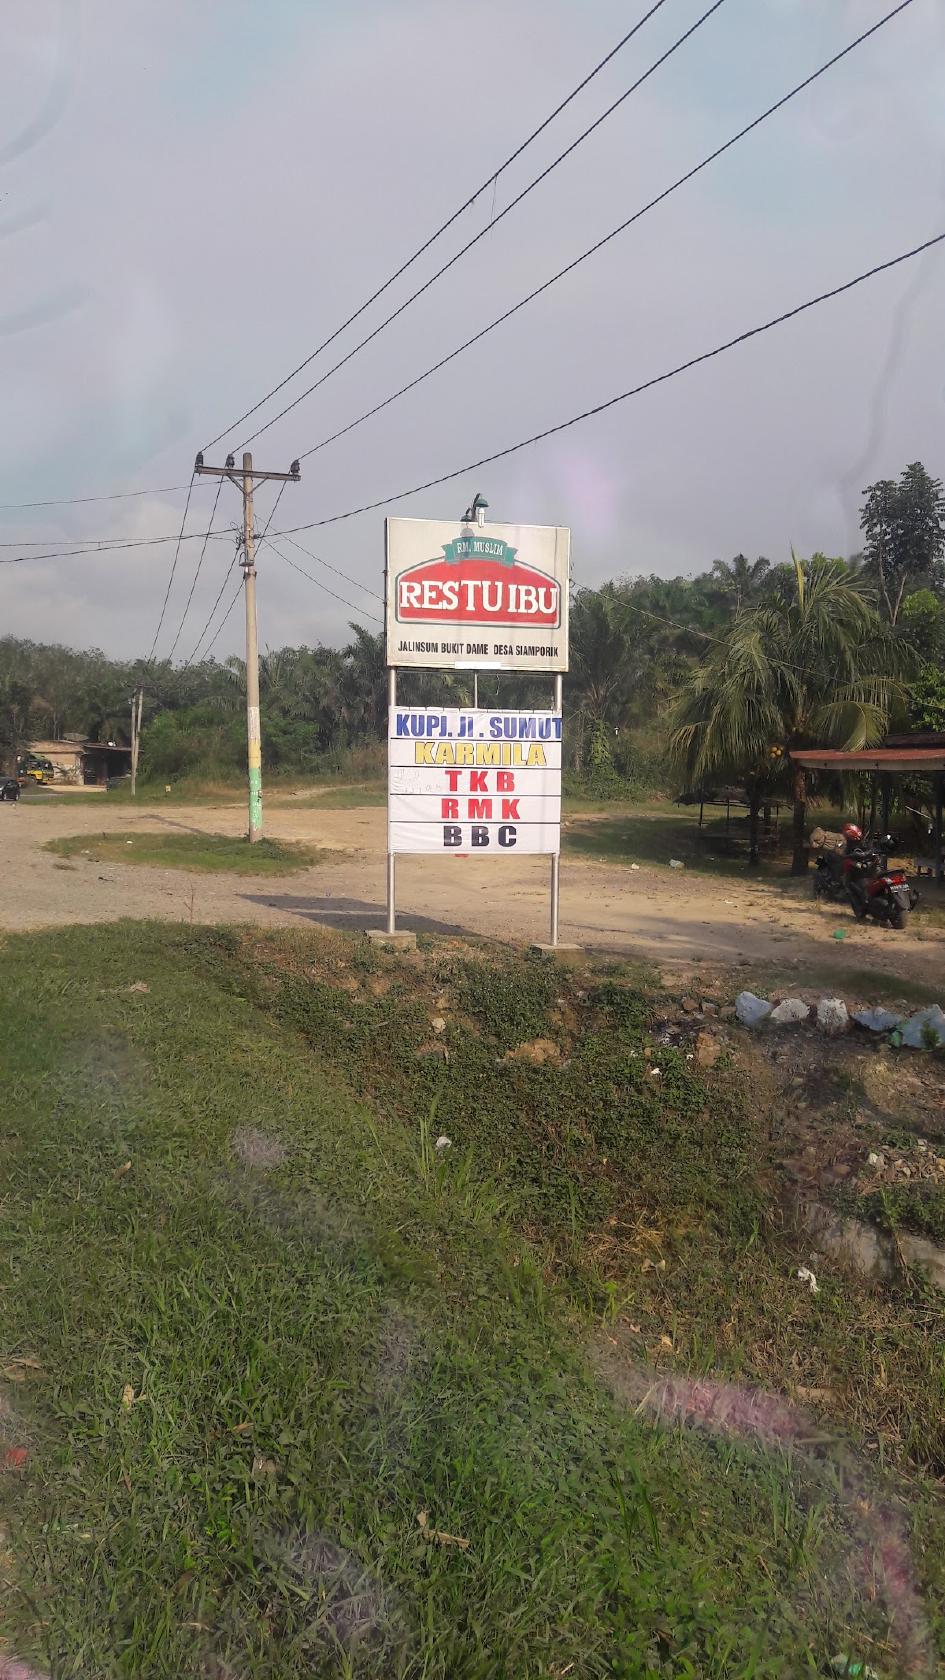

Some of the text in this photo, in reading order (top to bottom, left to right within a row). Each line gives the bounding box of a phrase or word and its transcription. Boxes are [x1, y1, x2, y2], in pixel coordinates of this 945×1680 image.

[474, 541, 503, 556] MUSLIM
[400, 580, 558, 614] RESTU IBU
[398, 641, 559, 657] JALINSUM BUKIT DAME DESA SIAMPORIK
[396, 713, 453, 737] KUPJ.
[489, 716, 562, 739] SUMUT
[414, 741, 547, 766] KARMILA
[445, 770, 515, 792] TKB
[441, 798, 521, 820] RMK
[443, 825, 517, 847] BBC
